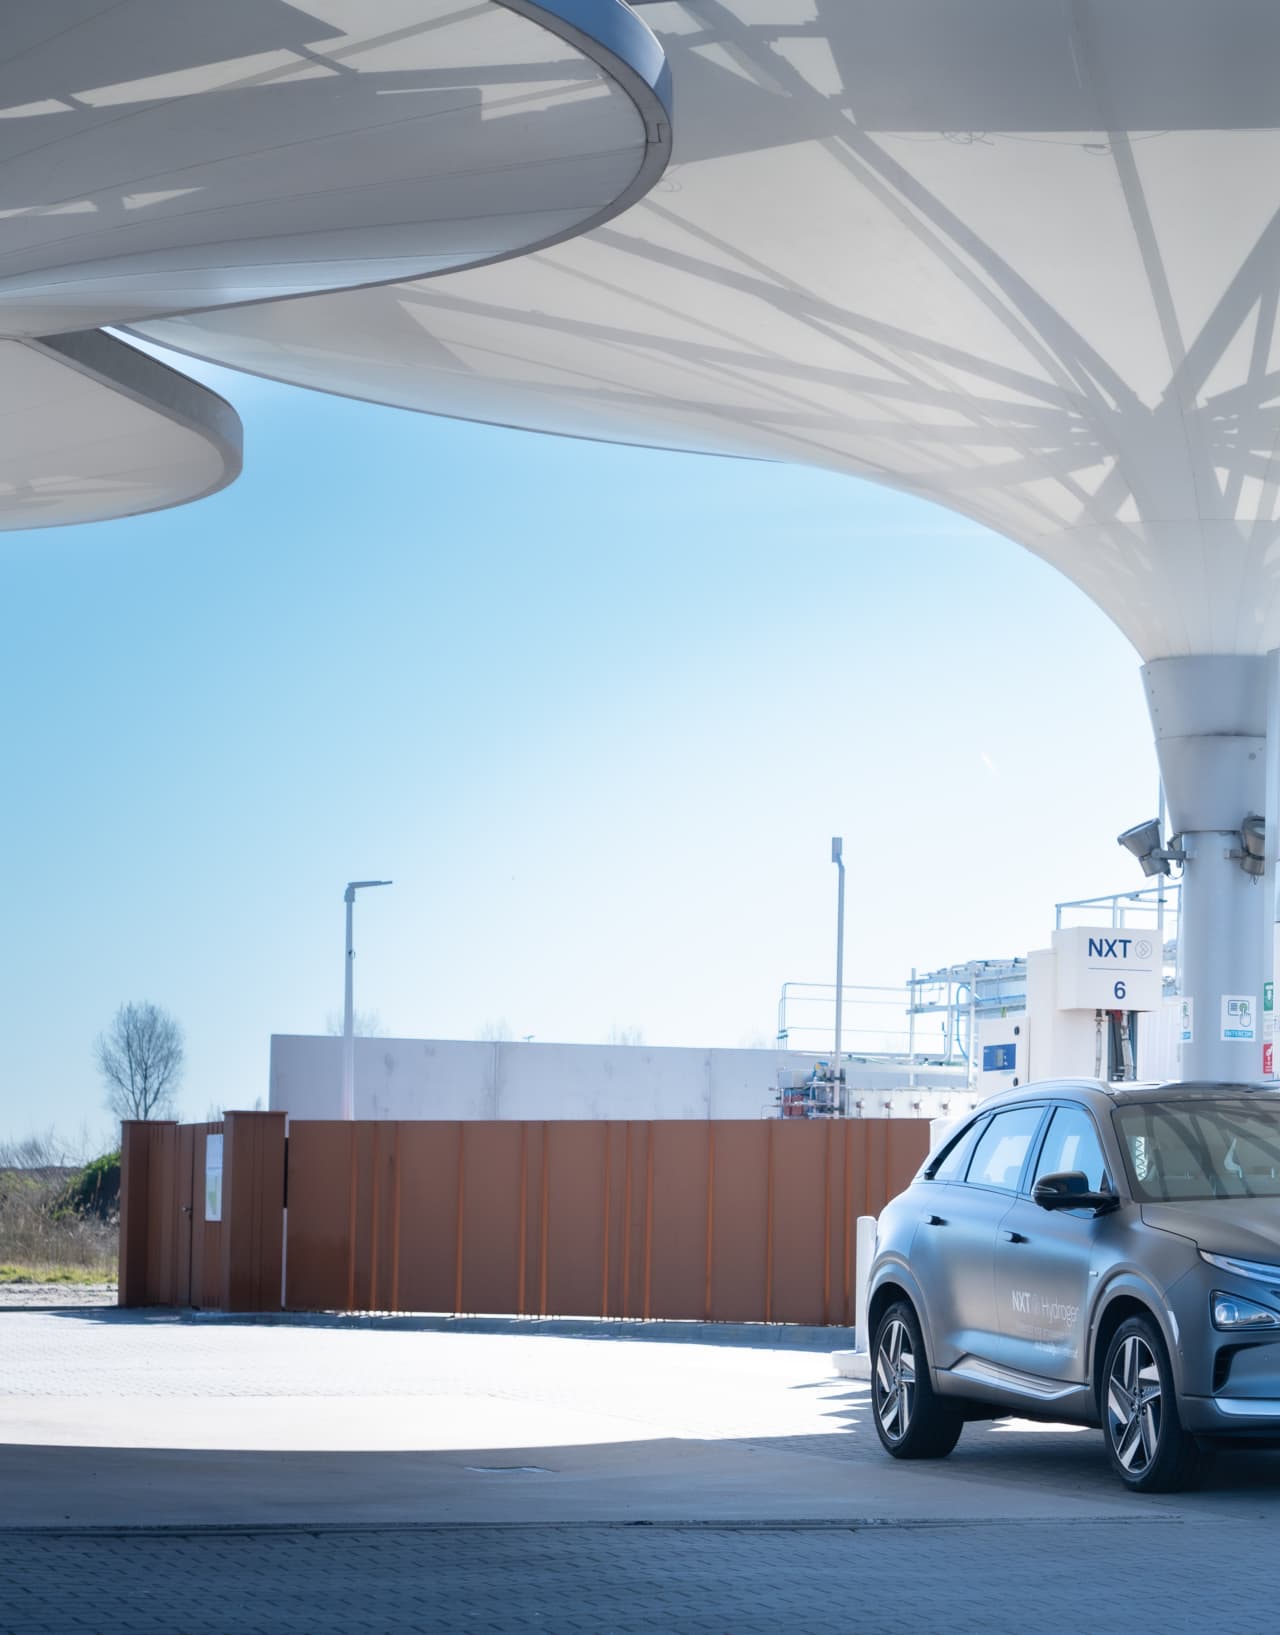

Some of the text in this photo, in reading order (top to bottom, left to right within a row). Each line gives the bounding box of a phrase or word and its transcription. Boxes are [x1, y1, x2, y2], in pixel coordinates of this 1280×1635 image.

[1088, 938, 1132, 958] NXT
[1113, 981, 1126, 1000] 6
[1012, 1290, 1031, 1313] NXT
